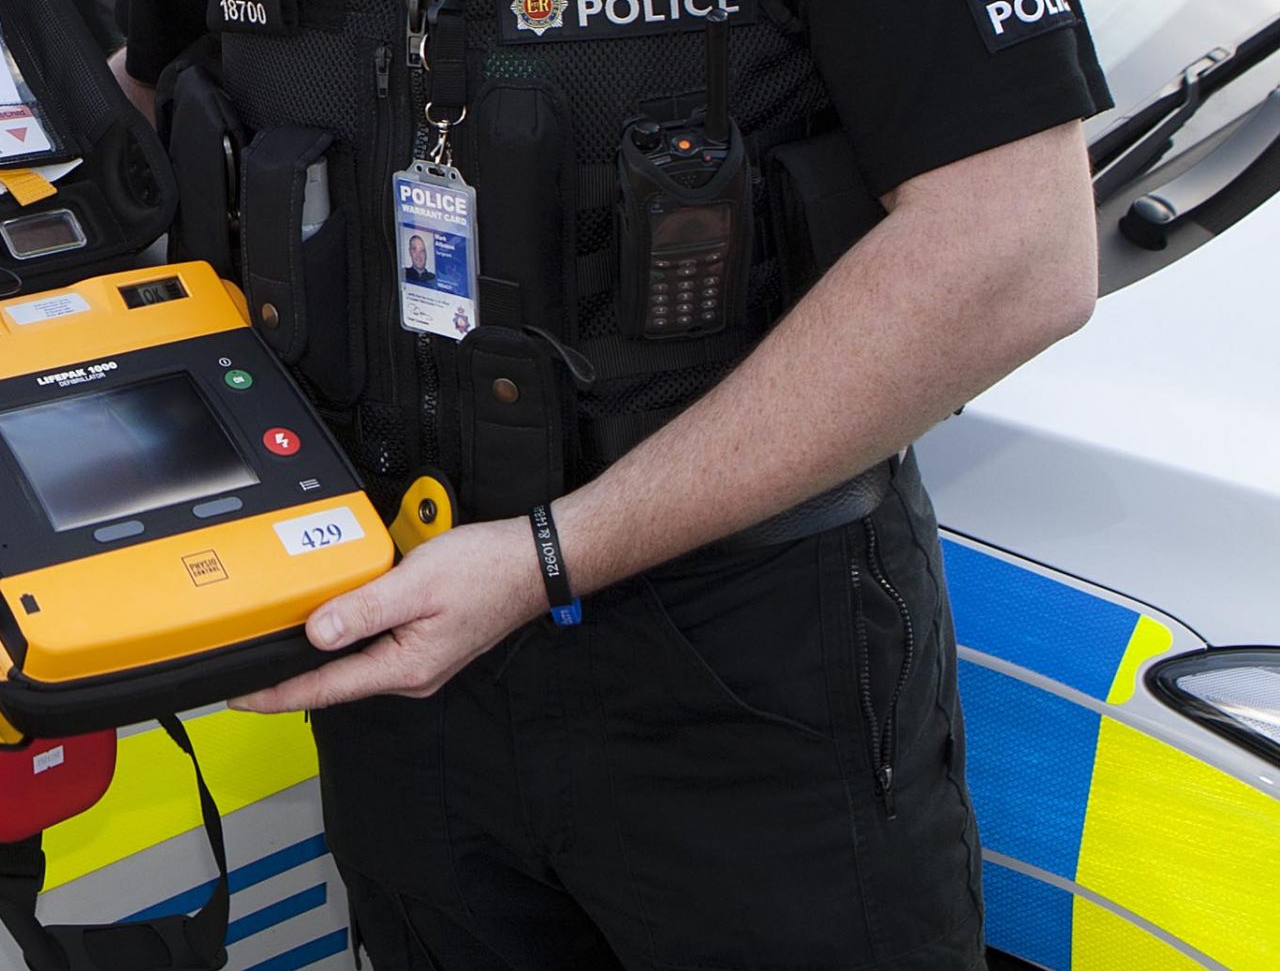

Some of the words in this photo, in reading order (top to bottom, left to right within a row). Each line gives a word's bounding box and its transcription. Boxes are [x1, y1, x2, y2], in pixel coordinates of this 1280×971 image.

[399, 185, 468, 216] POLICE
[401, 203, 443, 220] WARRANT
[443, 213, 467, 226] CARD
[141, 286, 165, 304] OK
[36, 368, 87, 386] LIFEPAK
[87, 361, 119, 375] 1000
[58, 372, 107, 387] DEFIBRILLATOR
[301, 523, 343, 549] 429
[189, 558, 218, 572] PHYSIO
[541, 542, 560, 578] 12601
[192, 566, 221, 578] CONTROL
